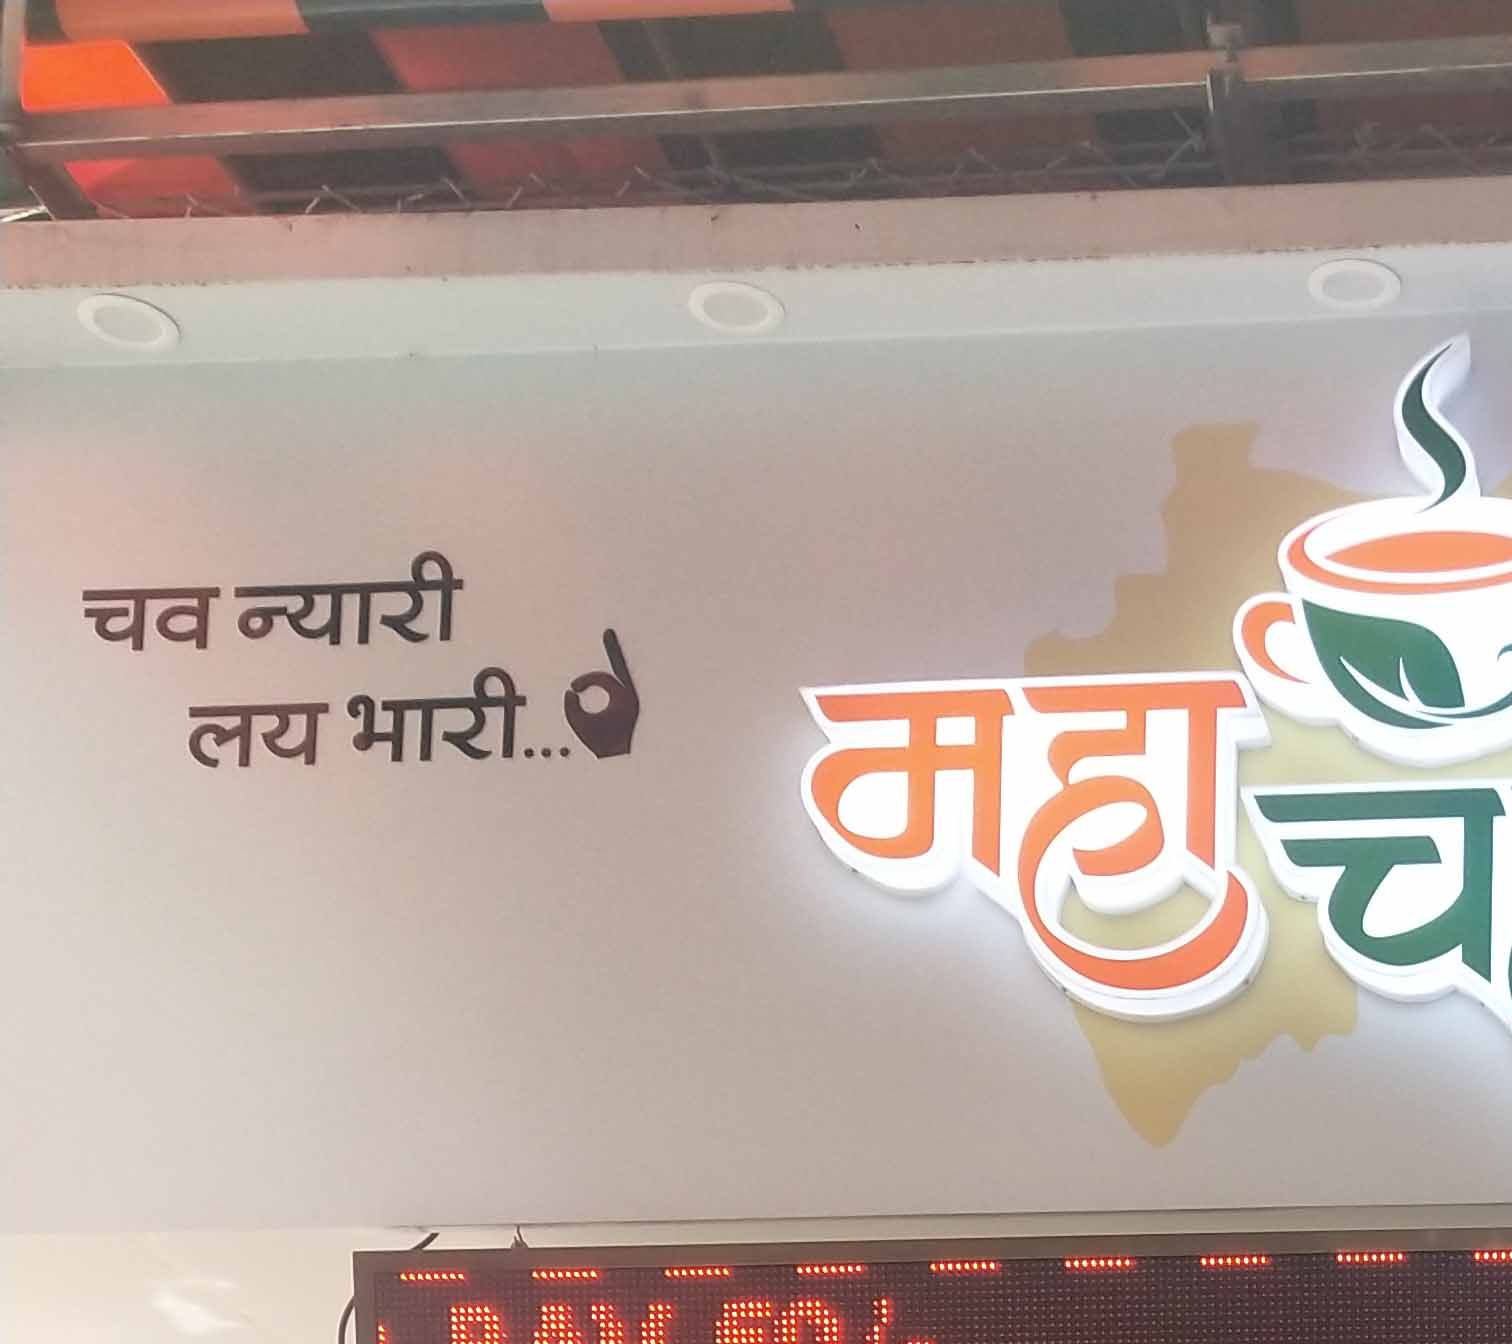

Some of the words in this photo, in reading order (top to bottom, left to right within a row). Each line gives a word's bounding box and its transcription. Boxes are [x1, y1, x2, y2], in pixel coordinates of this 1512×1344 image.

[82, 587, 220, 650] चव
[234, 550, 463, 646] न्यारी
[189, 701, 329, 768] लय
[804, 676, 1258, 1004] महा
